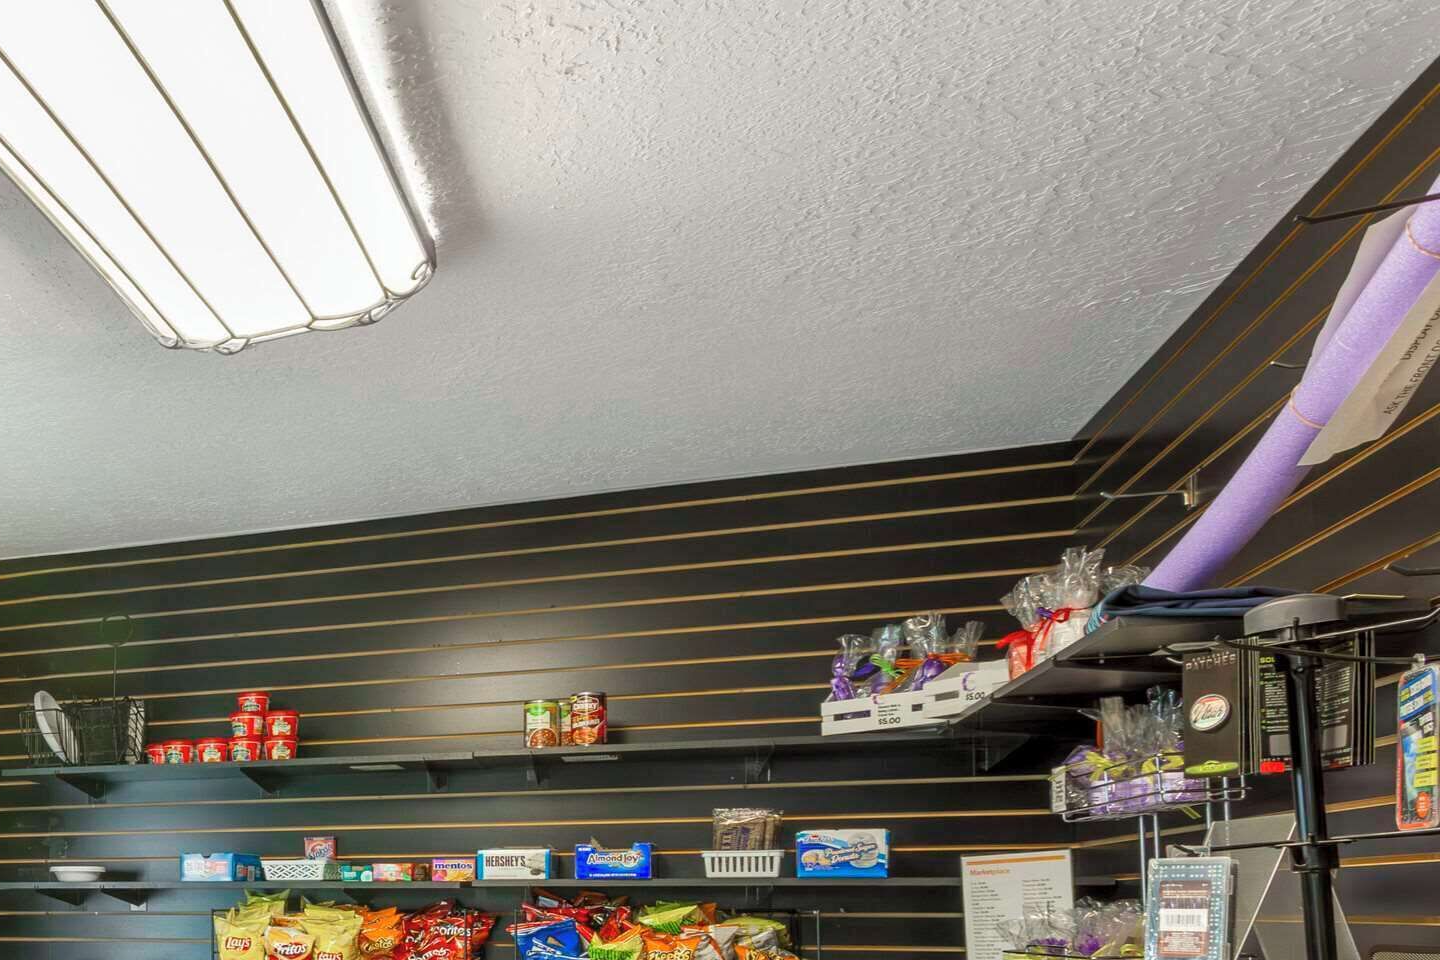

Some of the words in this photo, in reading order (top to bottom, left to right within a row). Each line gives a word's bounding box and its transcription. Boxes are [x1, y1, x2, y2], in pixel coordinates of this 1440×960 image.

[485, 855, 526, 869] HERSHEY'S
[587, 853, 622, 865] Almond
[435, 862, 473, 870] mentos
[273, 942, 308, 956] Fritos
